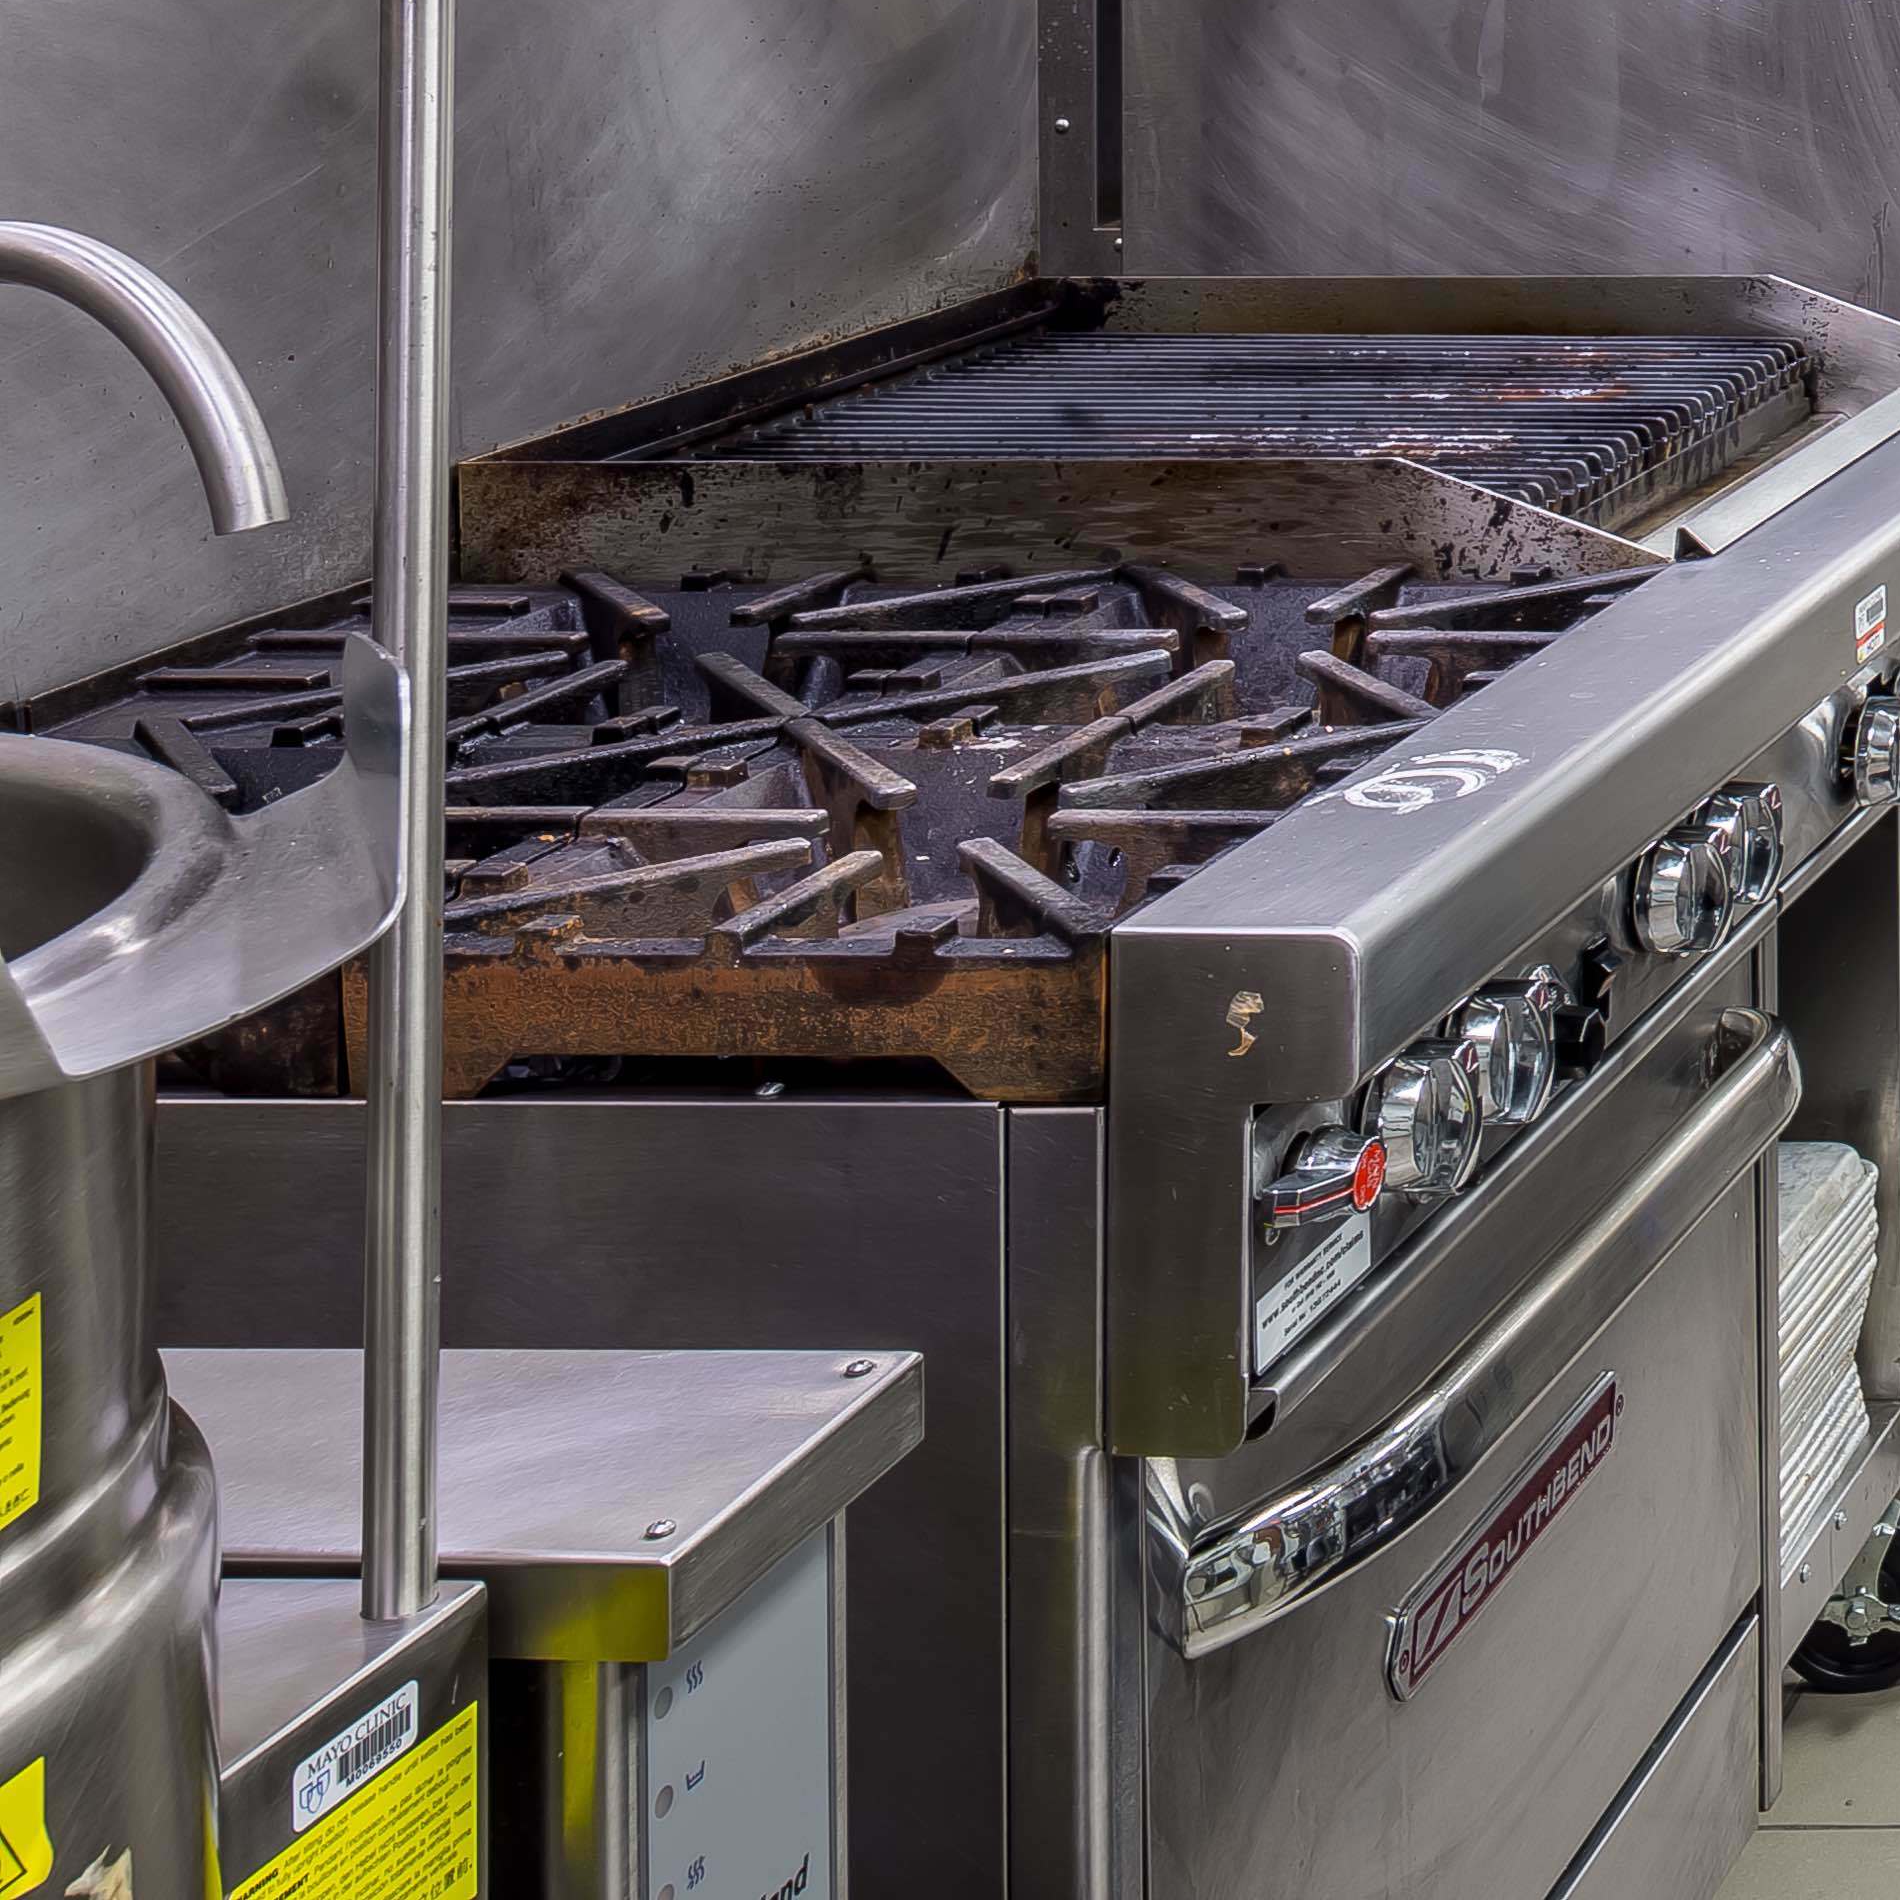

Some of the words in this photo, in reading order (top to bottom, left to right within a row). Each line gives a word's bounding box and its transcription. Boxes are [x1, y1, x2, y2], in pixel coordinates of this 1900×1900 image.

[1461, 1413, 1613, 1615] SOUTHBEND
[307, 1735, 351, 1779] MAYO
[355, 1692, 407, 1740] CLINIC
[345, 1737, 402, 1788] M0069550
